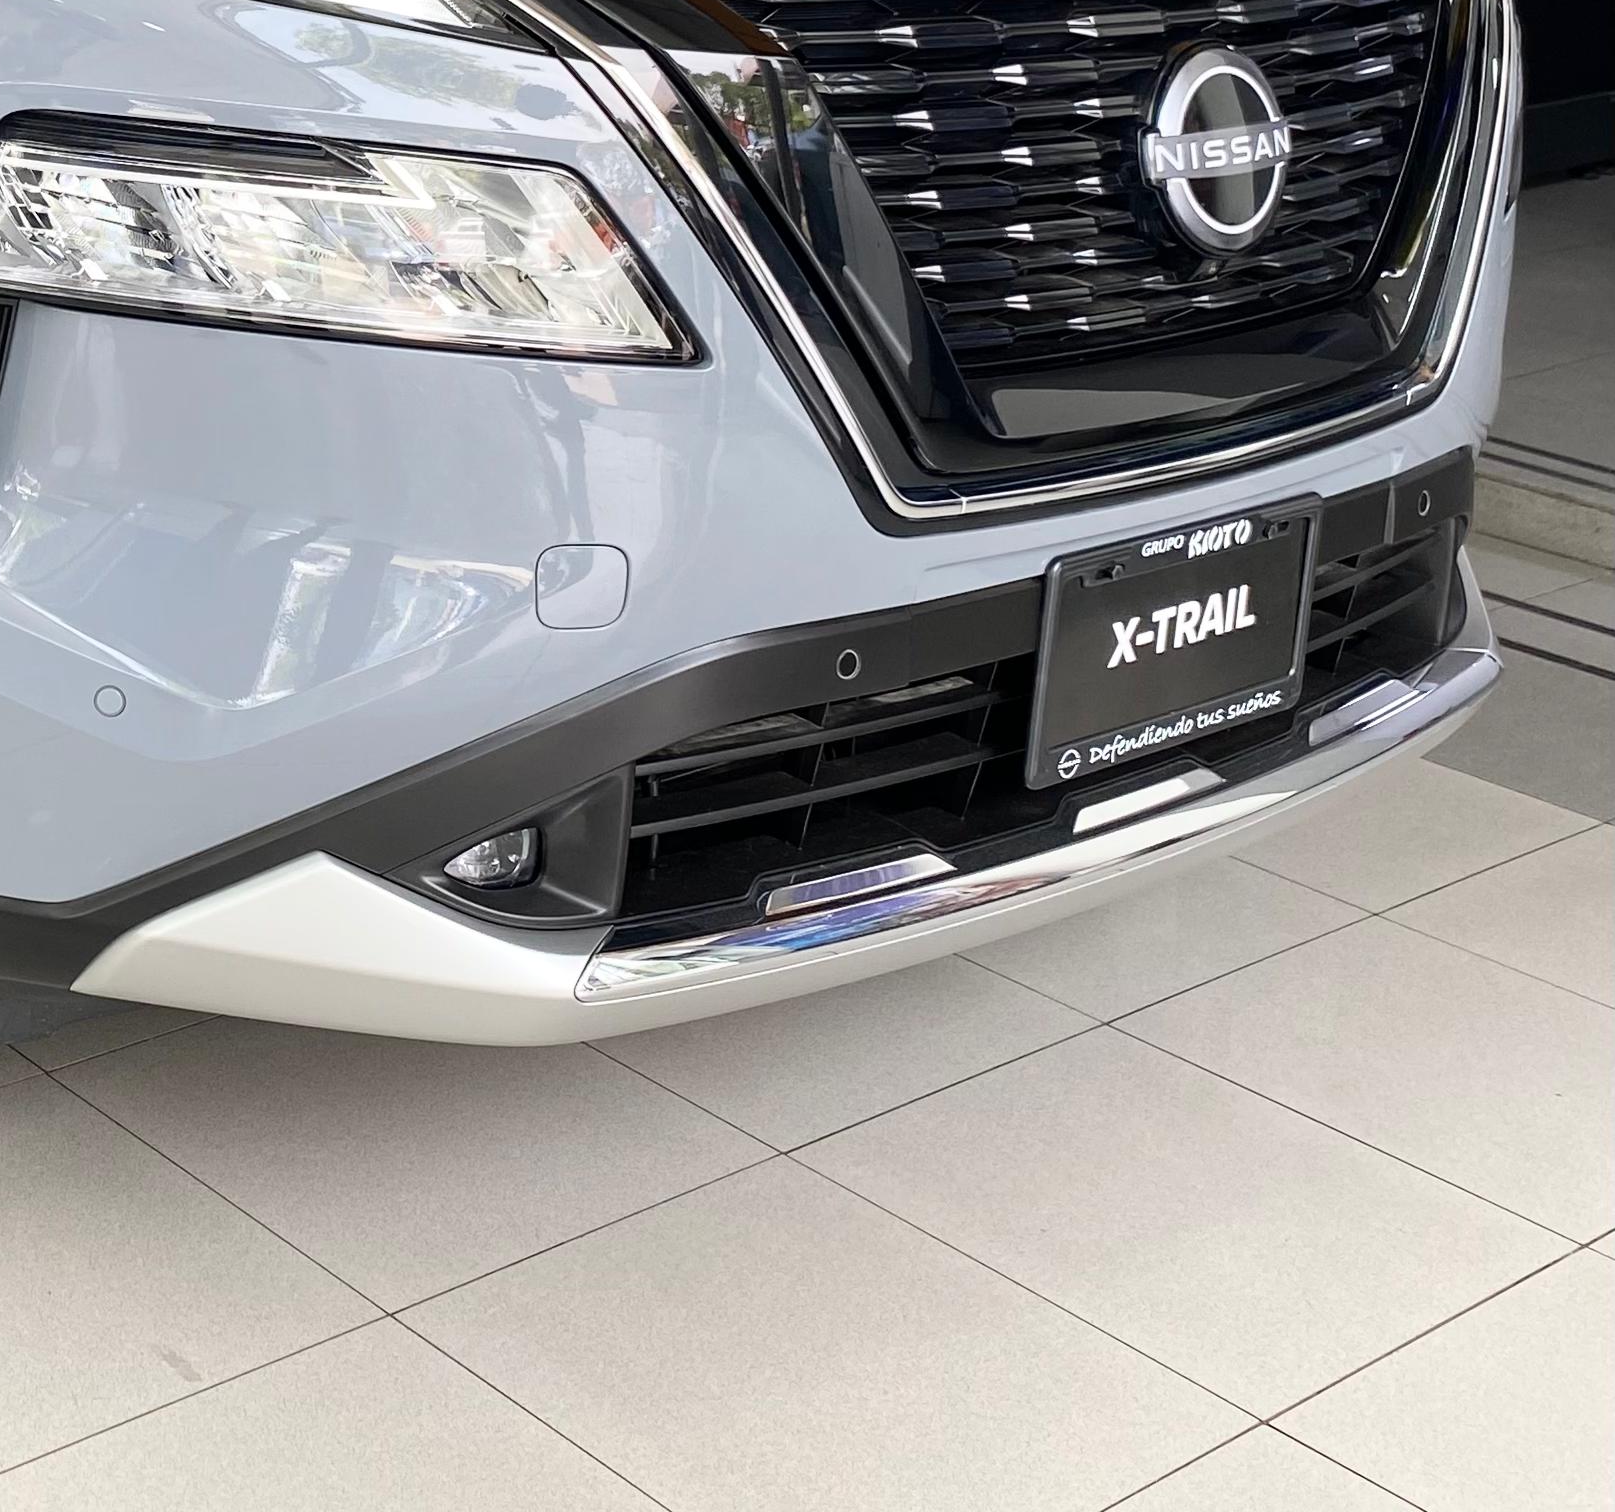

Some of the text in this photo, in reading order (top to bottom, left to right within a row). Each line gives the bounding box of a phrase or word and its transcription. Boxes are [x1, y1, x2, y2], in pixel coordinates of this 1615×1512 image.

[1153, 126, 1291, 173] NISSAN
[1141, 534, 1185, 558] GRUPO
[1106, 584, 1257, 670] X-TRAIL
[1089, 715, 1194, 764] Defendiendo
[1197, 710, 1225, 728] tus
[1227, 689, 1282, 721] sueños
